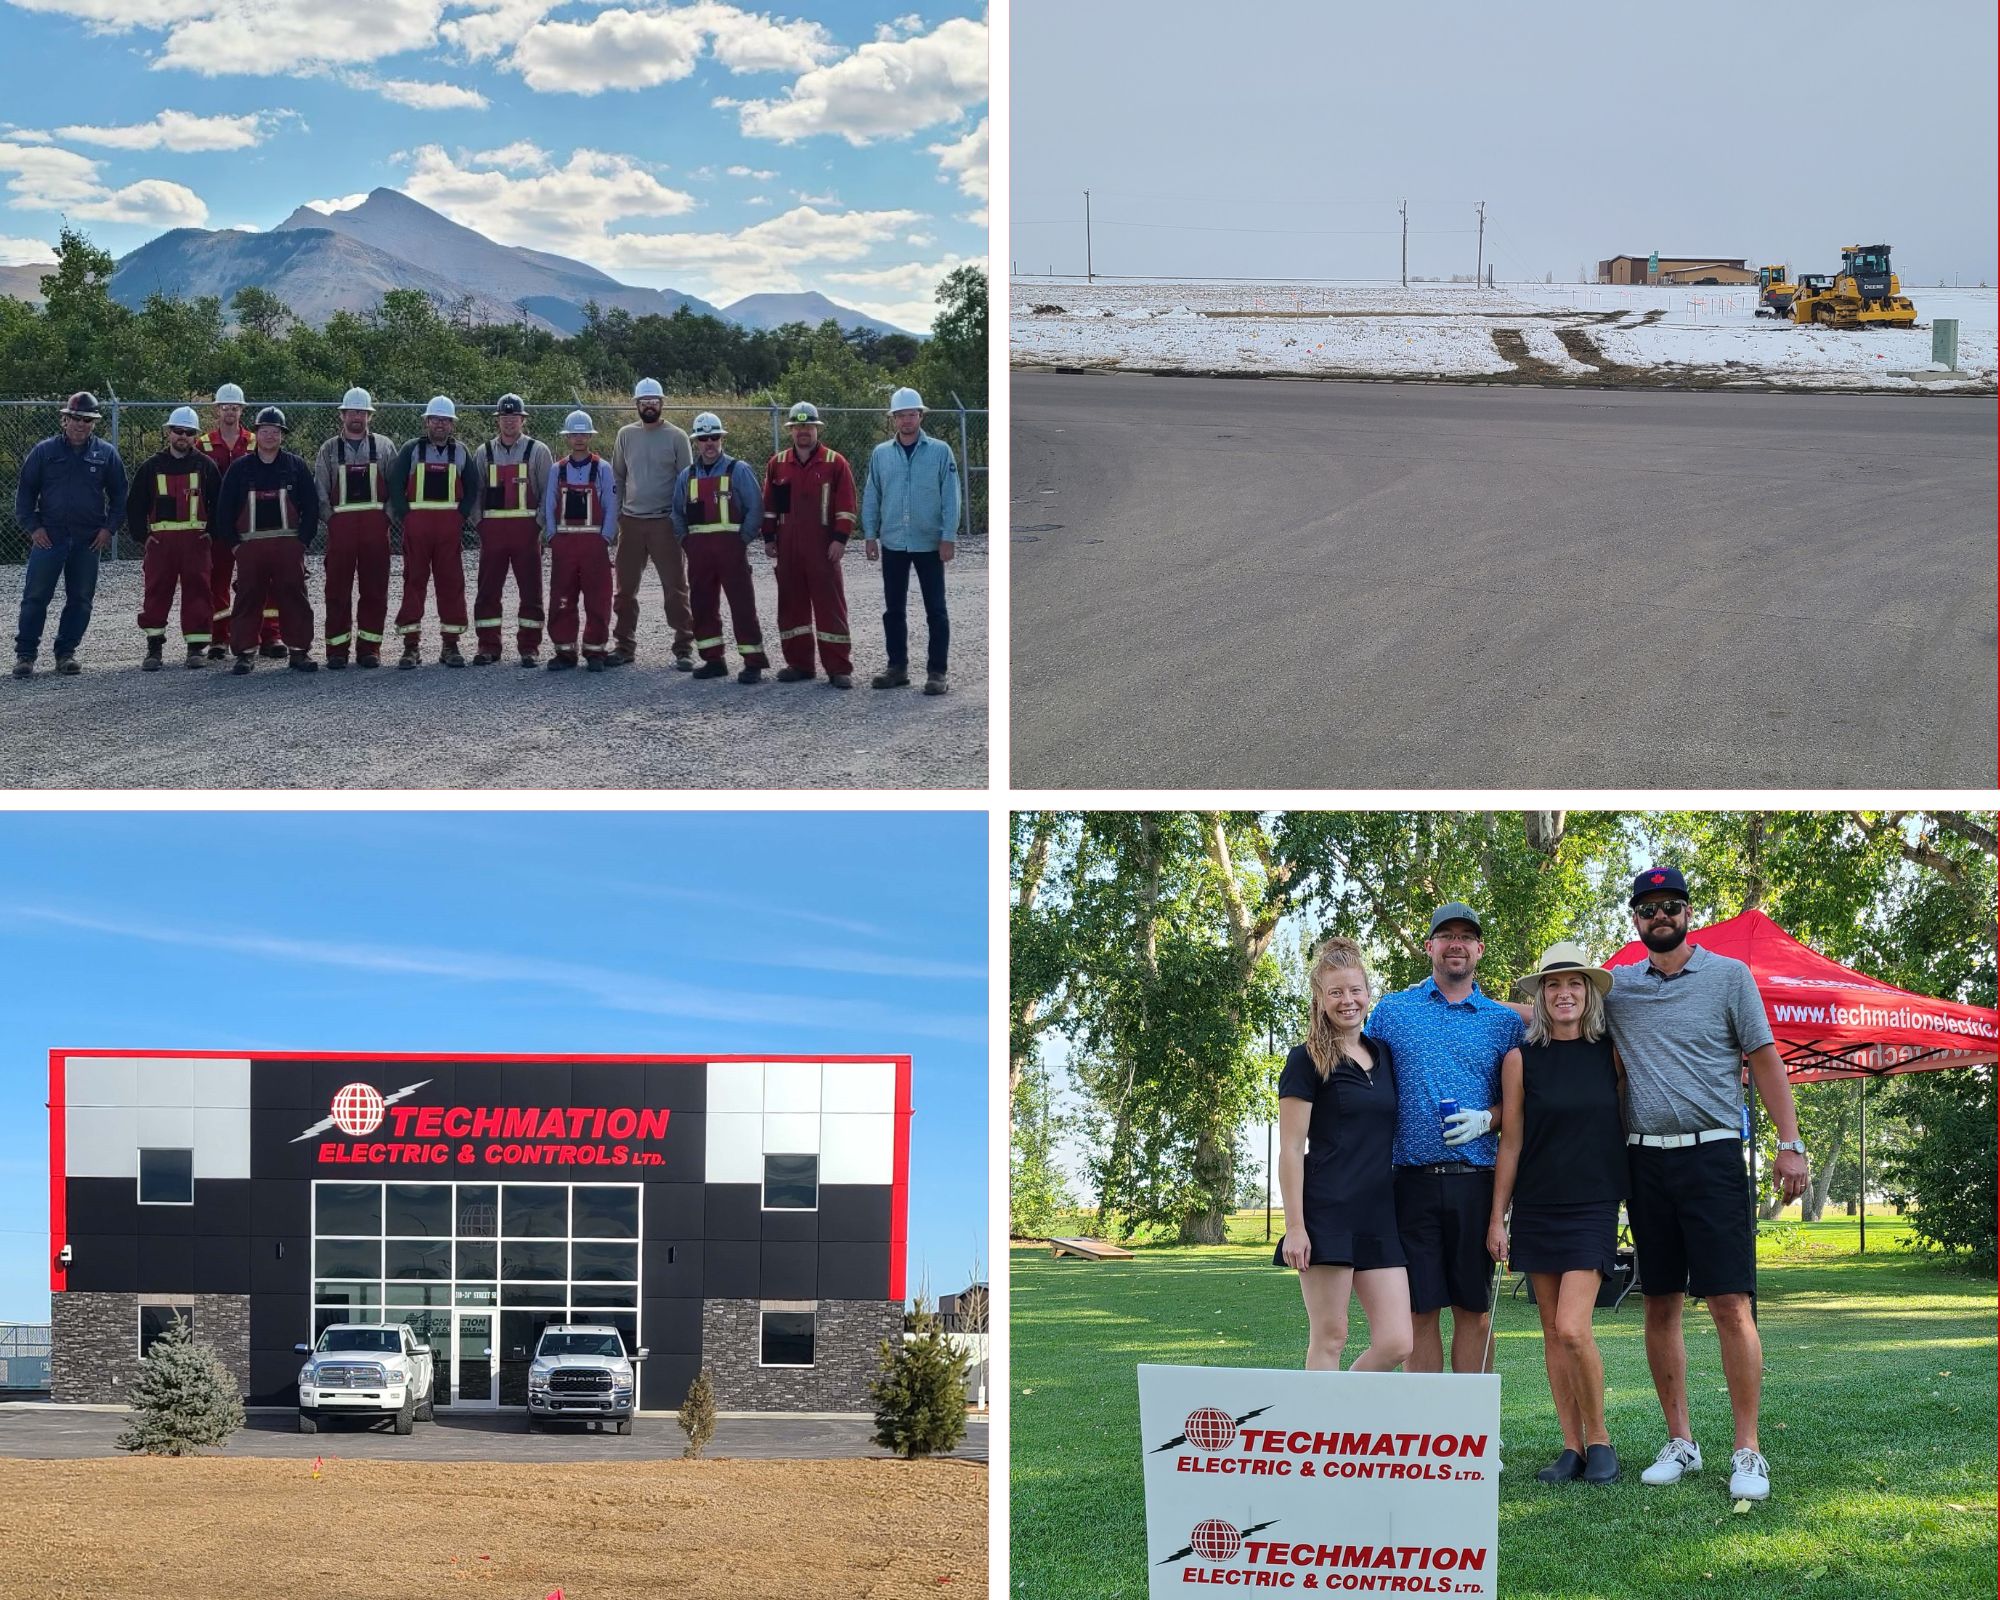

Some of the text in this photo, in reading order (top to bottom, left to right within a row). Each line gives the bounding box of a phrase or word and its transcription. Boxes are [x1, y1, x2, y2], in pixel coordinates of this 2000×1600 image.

[1773, 1002, 1998, 1039] www.techmationelectric.
[390, 1106, 671, 1139] TECHMATION
[318, 1143, 666, 1165] ELECTRIC & CONTROLS LTD.
[1239, 1429, 1488, 1458] TECHMATION
[1177, 1456, 1485, 1481] ELECTRIC & CONTROLS LTD.
[1244, 1541, 1487, 1571] TECHMATION
[1182, 1568, 1484, 1594] ELECTRIC & CONTROLS LTD.
